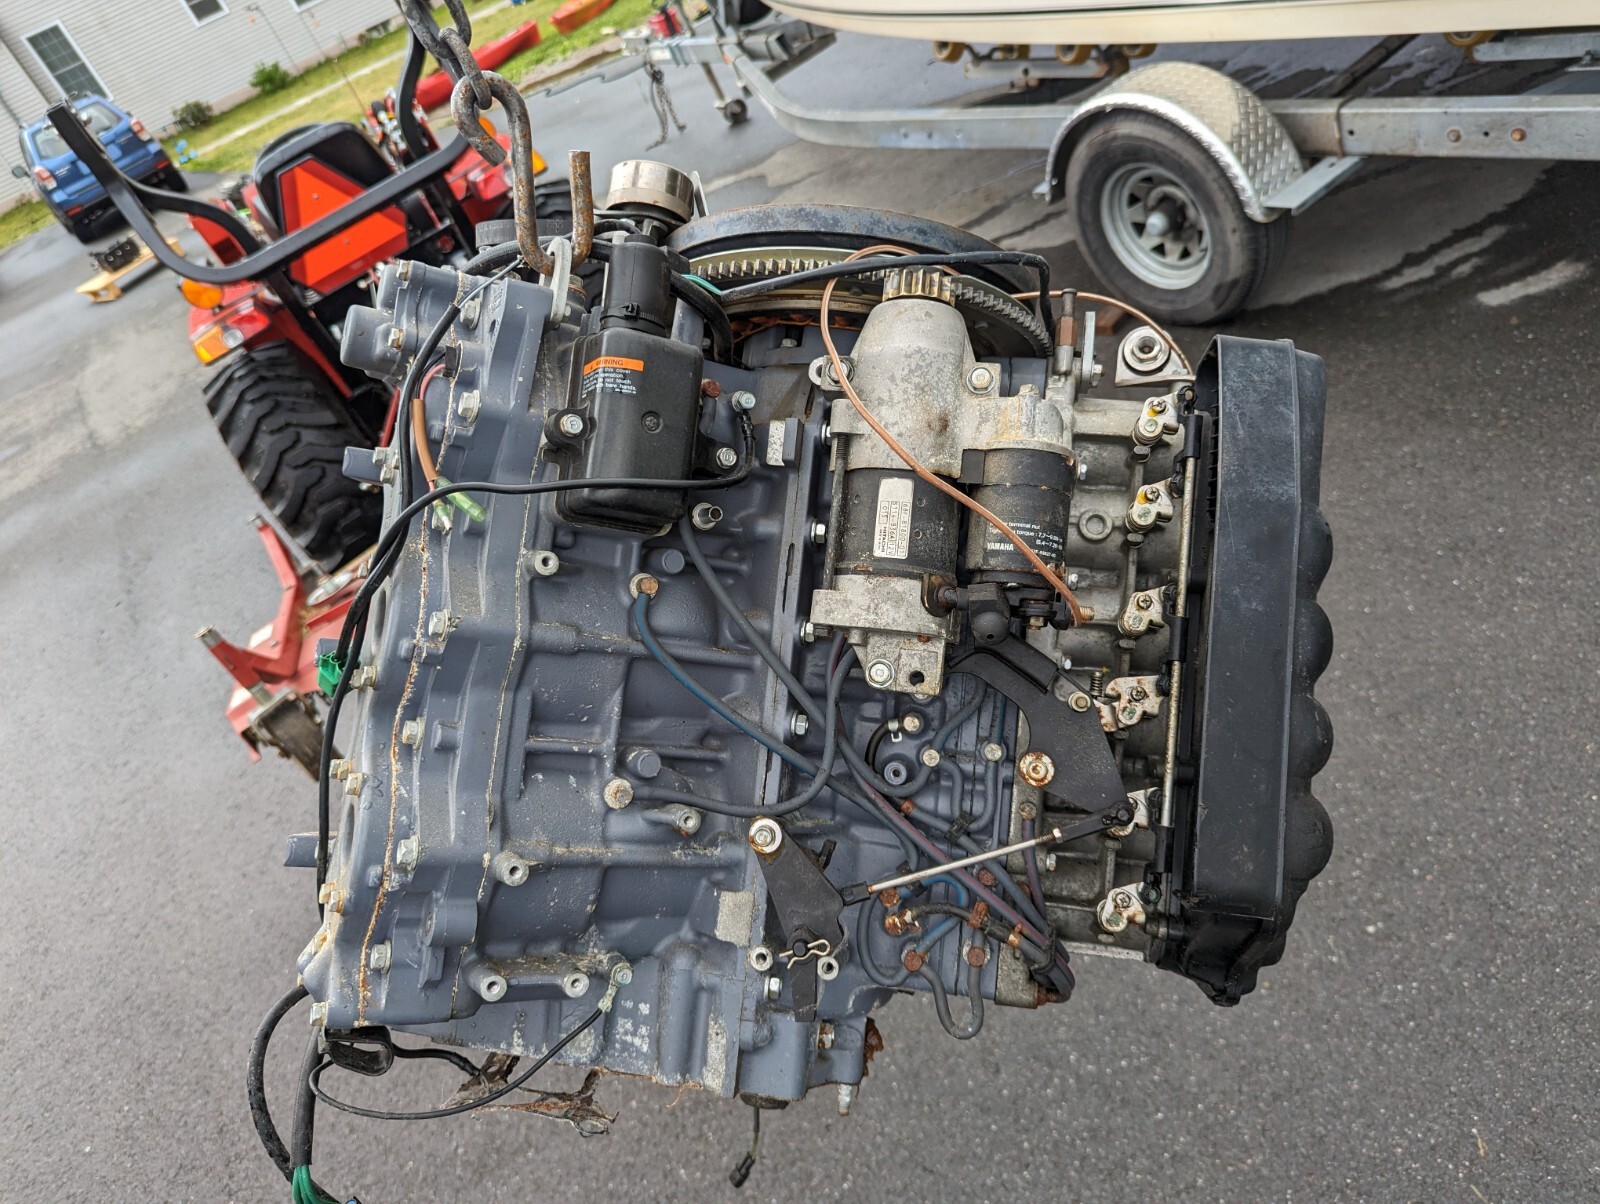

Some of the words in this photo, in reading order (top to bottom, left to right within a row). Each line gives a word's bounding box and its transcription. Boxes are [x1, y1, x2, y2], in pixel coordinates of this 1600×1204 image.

[595, 358, 624, 367] WARNING
[1016, 529, 1035, 537] torque
[987, 542, 1014, 551] YAMAHA
